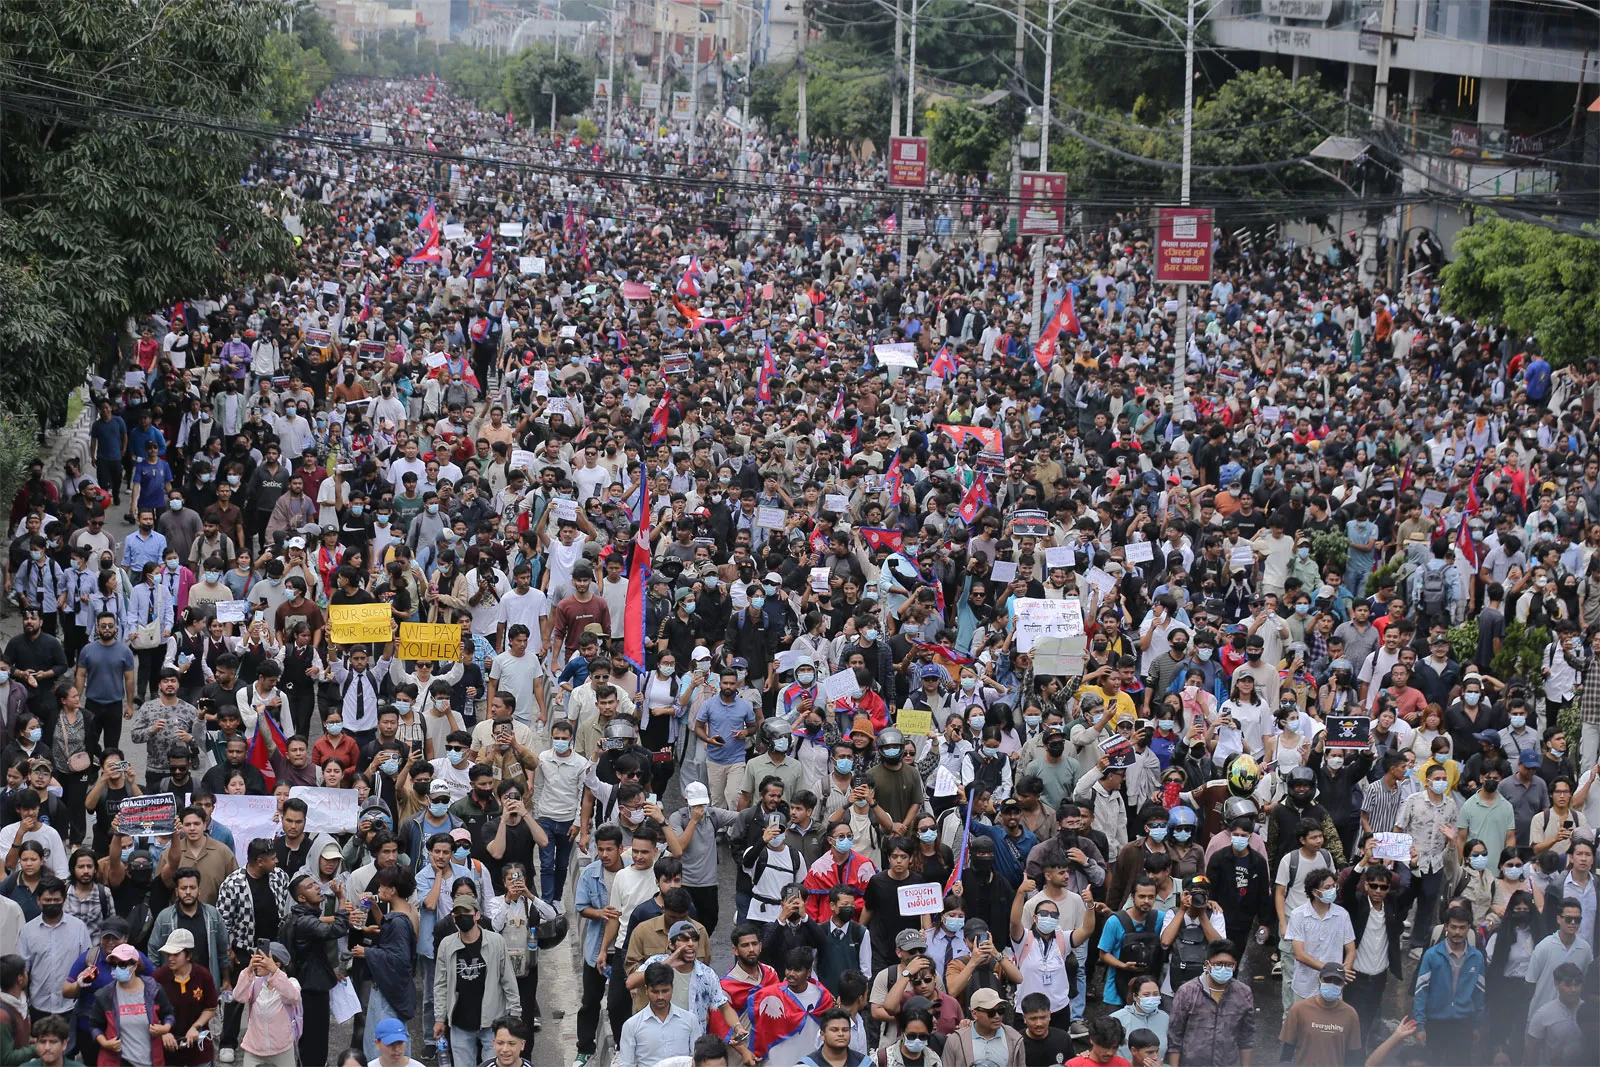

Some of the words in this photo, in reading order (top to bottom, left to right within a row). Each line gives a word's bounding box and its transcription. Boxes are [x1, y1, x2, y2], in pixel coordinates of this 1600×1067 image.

[331, 608, 360, 621] OUR
[331, 627, 357, 640] YOUR
[362, 625, 391, 637] POCKET
[405, 625, 429, 640] WE
[119, 797, 173, 809] #WAKEUPNEPAL
[904, 887, 933, 897] ENOUGH
[907, 897, 937, 908] ENOUGH
[1311, 1021, 1344, 1033] Everything
